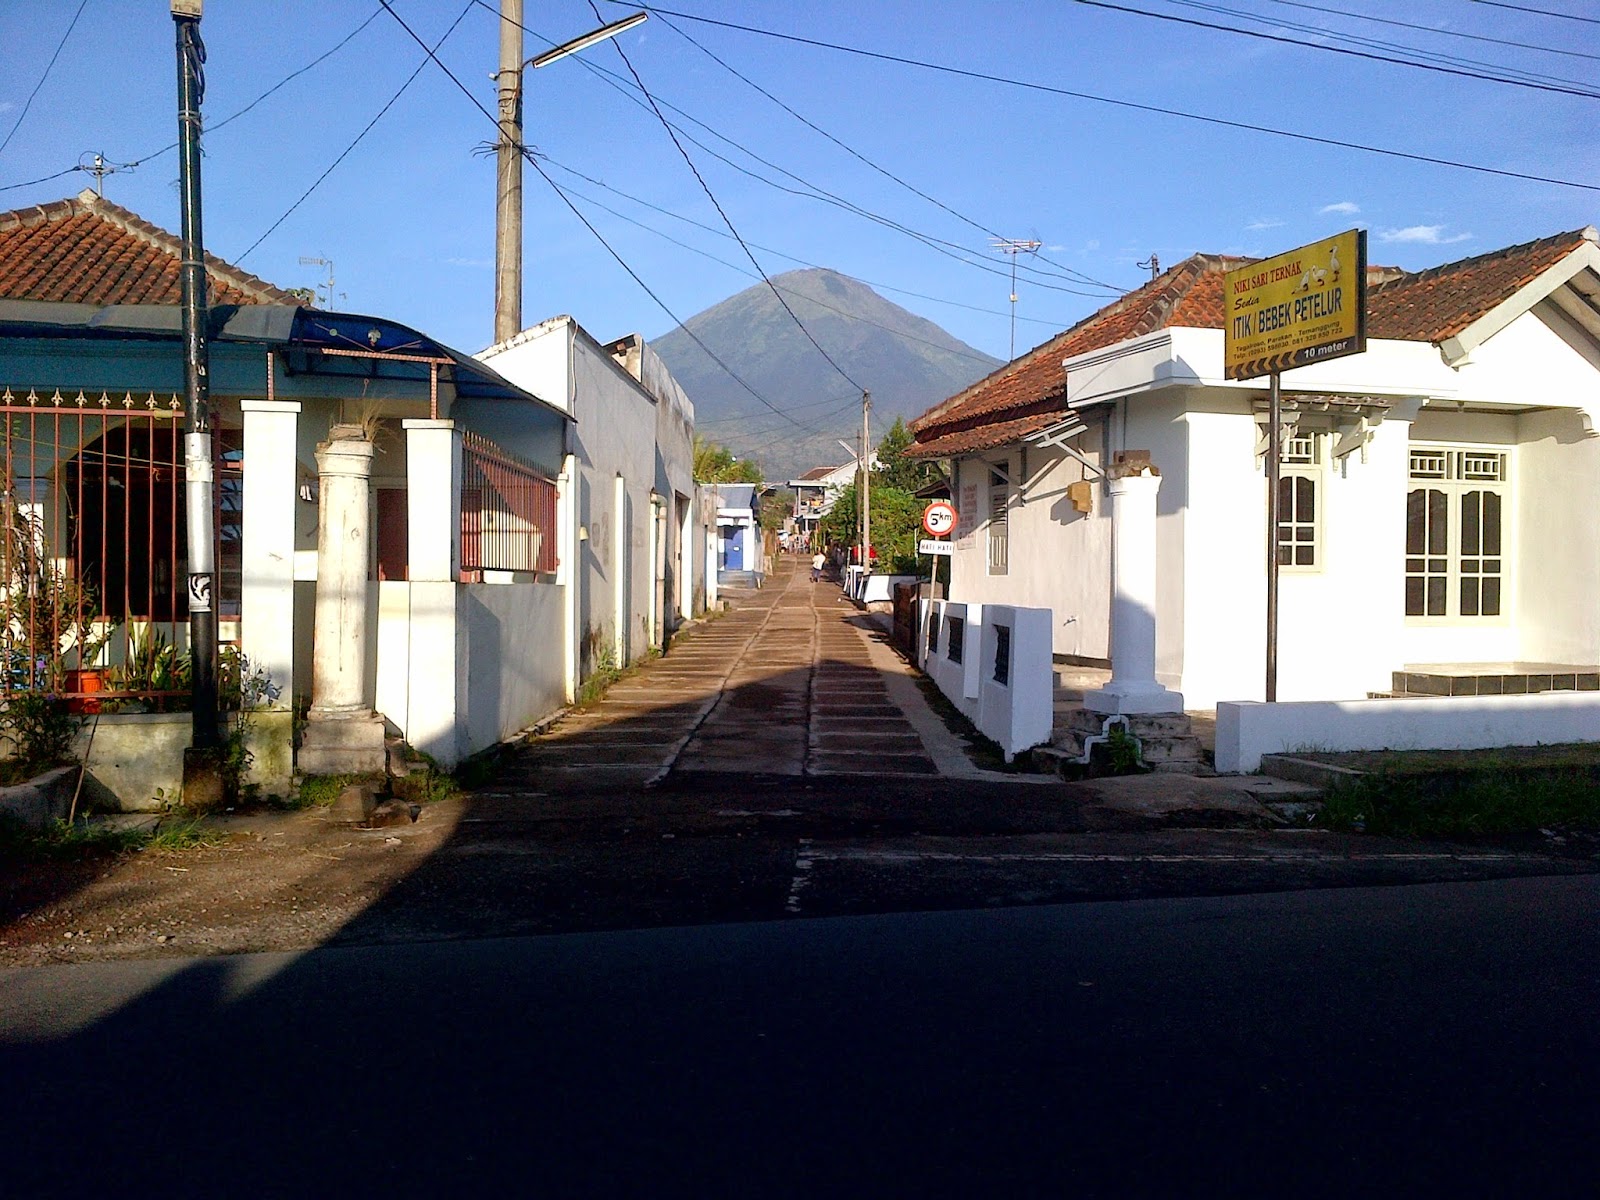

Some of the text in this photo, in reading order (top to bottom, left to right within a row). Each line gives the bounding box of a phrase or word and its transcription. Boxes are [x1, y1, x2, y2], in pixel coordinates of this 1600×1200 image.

[1233, 261, 1302, 295] NIKI SARI TERNAK
[1233, 297, 1260, 311] Sedia
[1233, 313, 1251, 340] ITIK
[1258, 302, 1292, 333] BEBEK
[1294, 287, 1342, 324] PETELUR
[1267, 333, 1293, 344] Parakan
[1298, 320, 1340, 336] Temanggung
[1304, 341, 1348, 359] 10 meter
